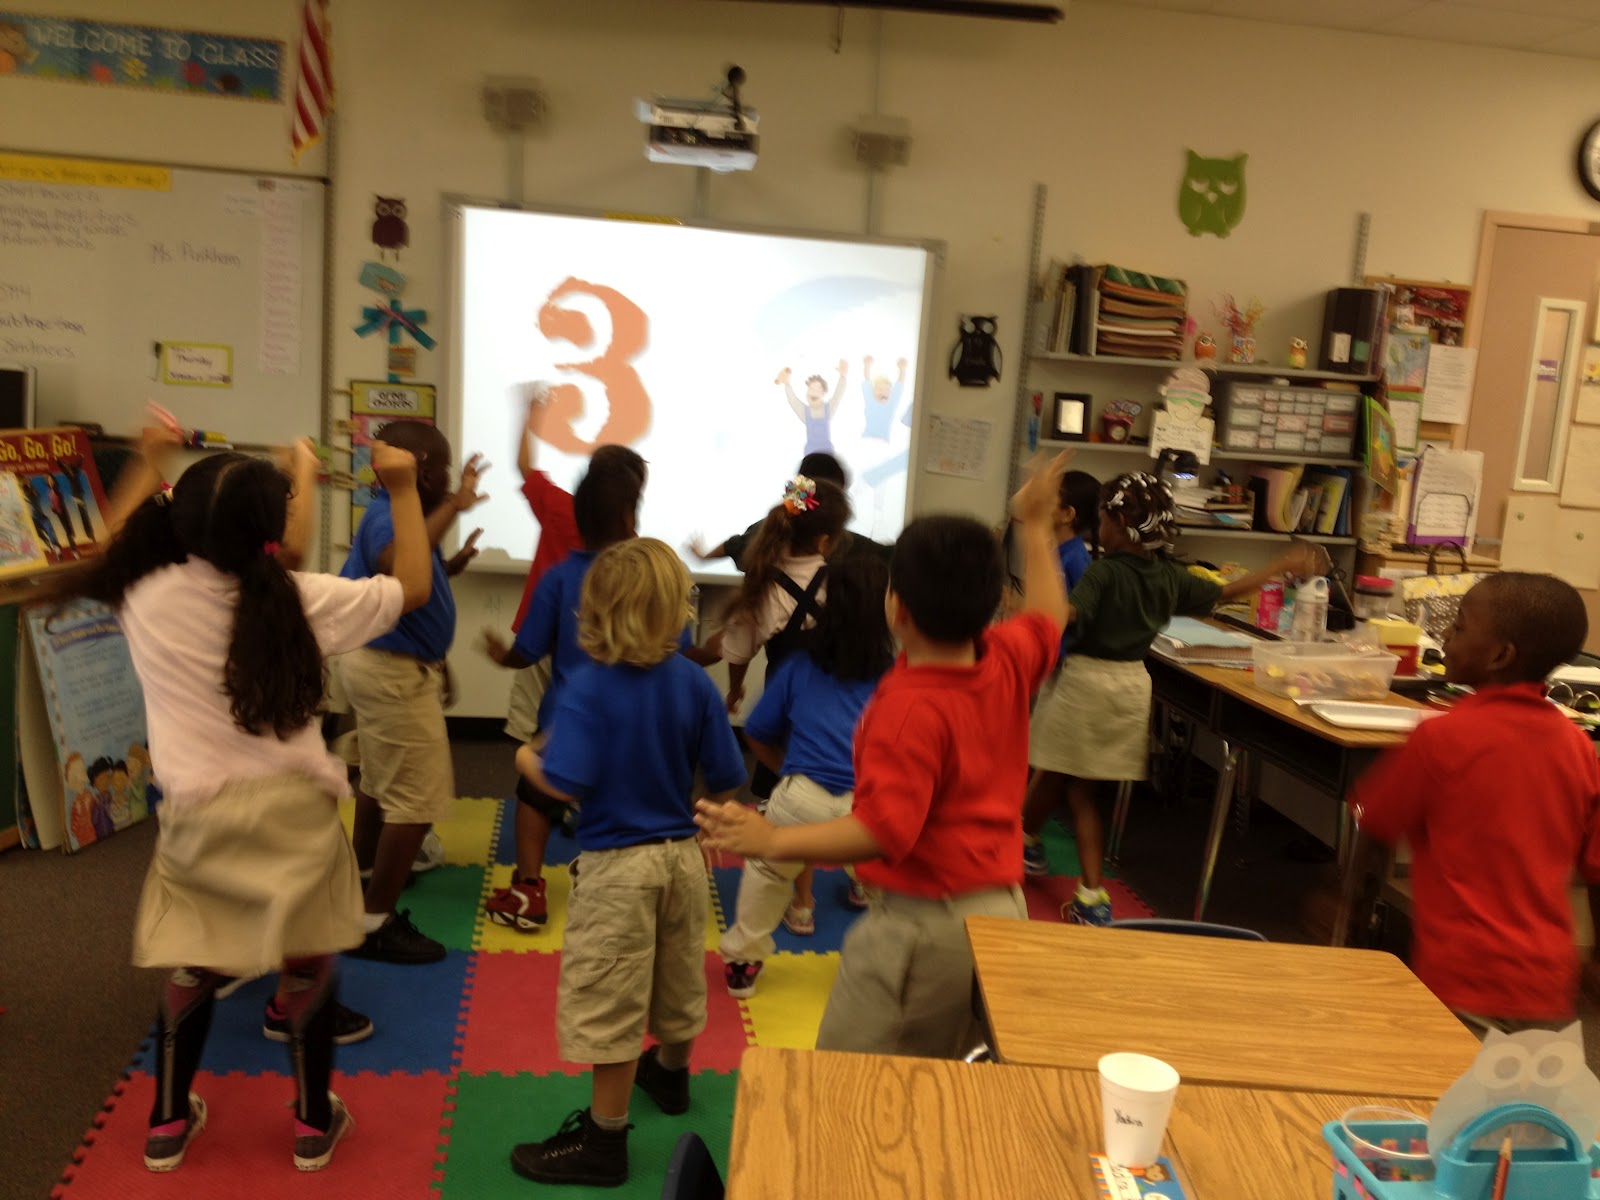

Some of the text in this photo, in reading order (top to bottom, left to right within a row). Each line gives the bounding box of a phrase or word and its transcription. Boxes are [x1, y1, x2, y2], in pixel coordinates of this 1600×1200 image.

[30, 25, 278, 69] WELCOME TO CLASS
[529, 275, 653, 455] 3
